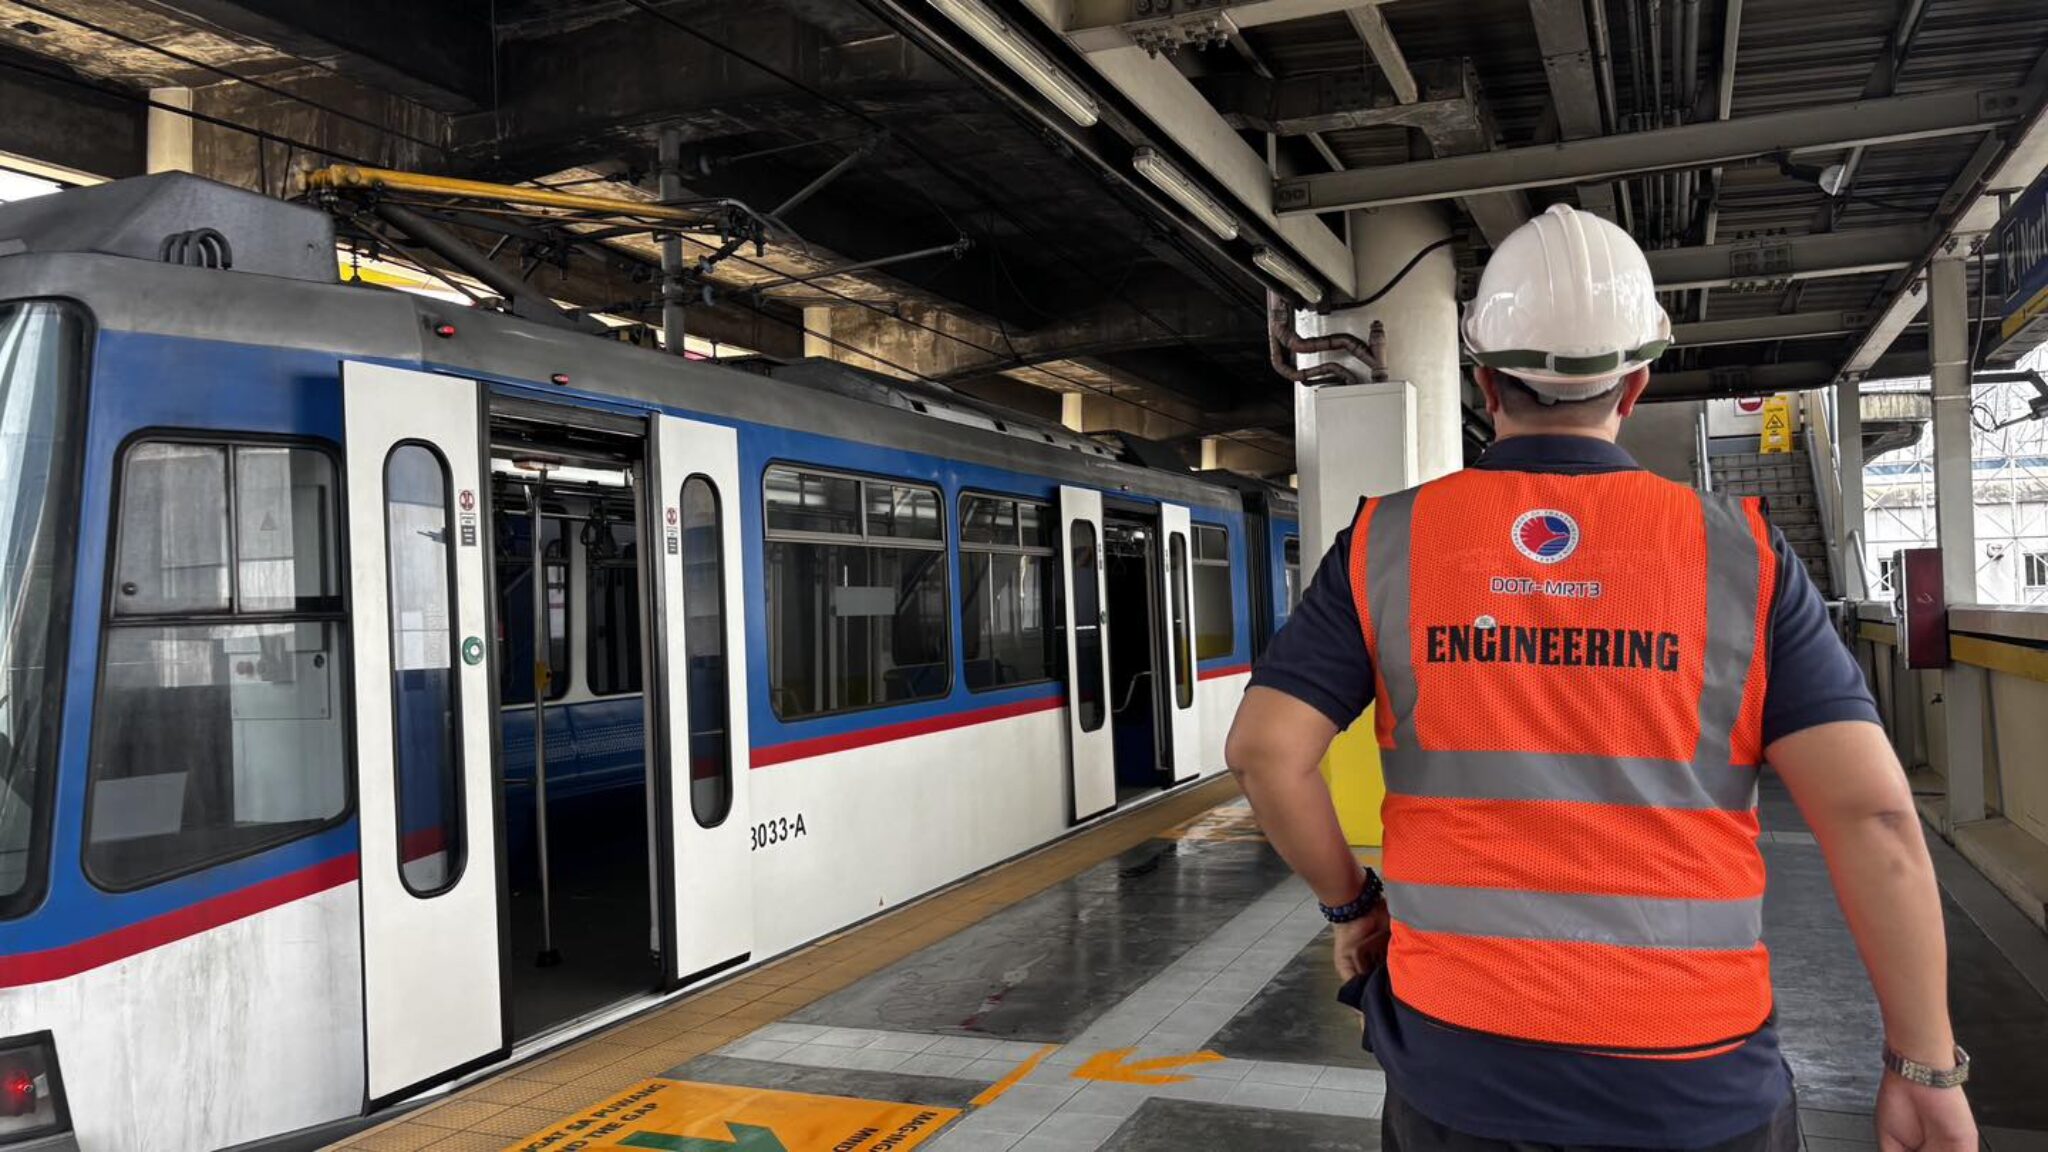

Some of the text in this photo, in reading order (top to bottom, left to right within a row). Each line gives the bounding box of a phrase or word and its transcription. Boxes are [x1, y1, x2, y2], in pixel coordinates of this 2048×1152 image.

[2021, 192, 2048, 275] Nort
[1426, 624, 1679, 672] ENGINEERING
[750, 812, 807, 852] 3033-A
[584, 1121, 626, 1138] THE
[620, 1102, 658, 1121] GAP
[869, 1110, 938, 1152] MAG-ING
